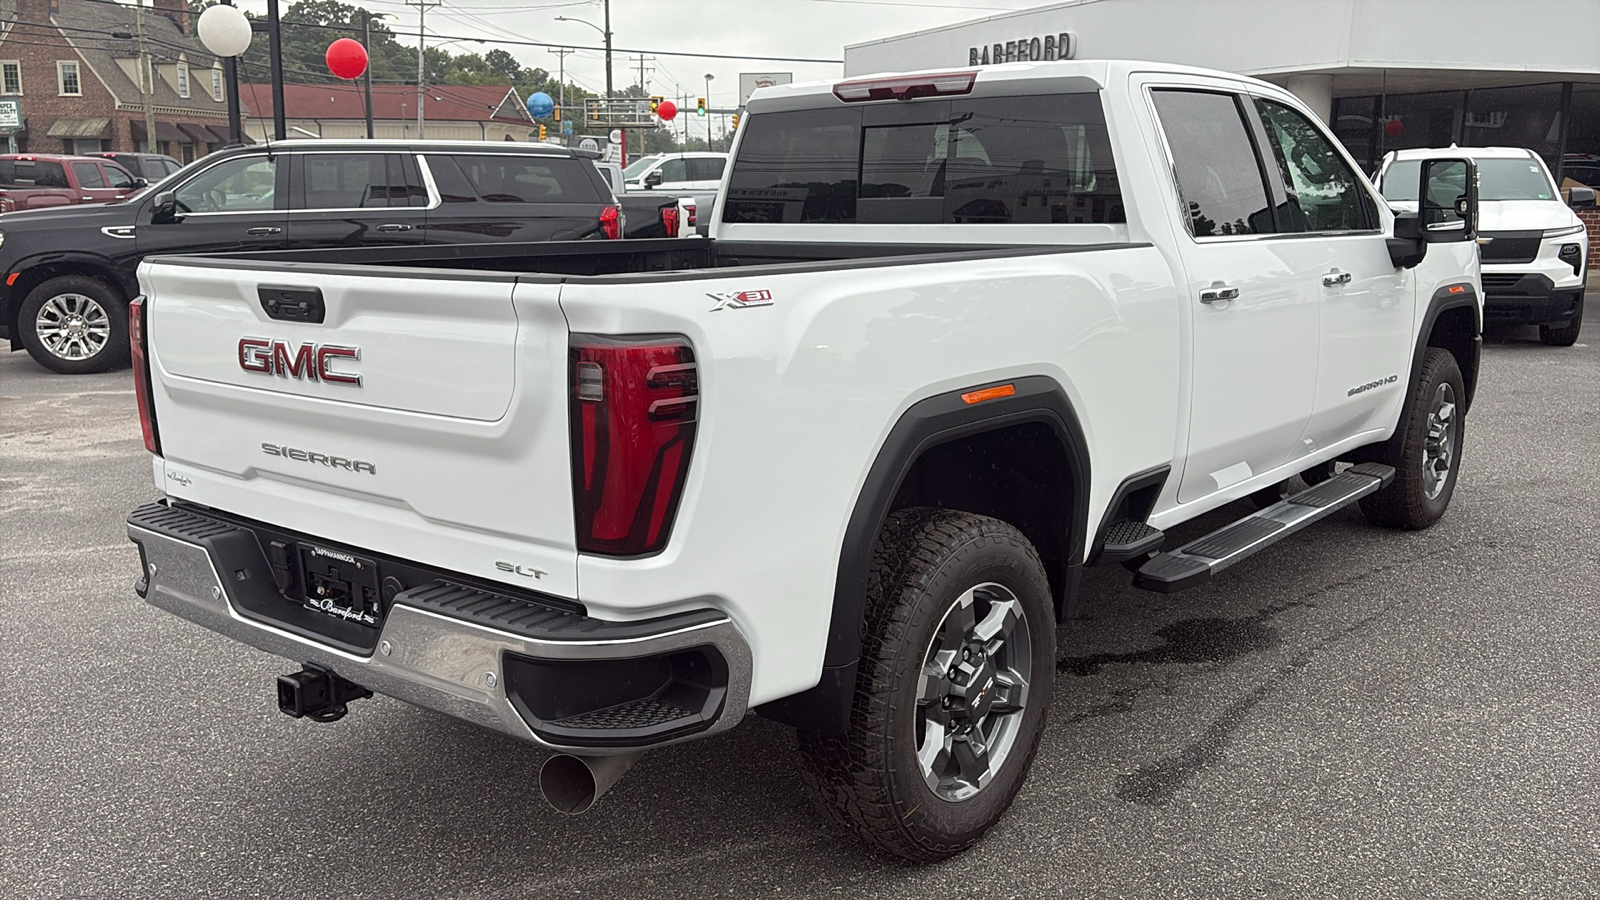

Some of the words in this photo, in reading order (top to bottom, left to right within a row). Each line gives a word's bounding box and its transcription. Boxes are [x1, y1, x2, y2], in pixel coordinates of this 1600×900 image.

[238, 336, 363, 388] GMC
[1347, 378, 1384, 397] SIERRA
[1384, 374, 1398, 385] HD
[261, 442, 376, 475] SIERRA
[314, 547, 356, 564] TAPPAHANNOCK
[495, 561, 548, 580] SLT
[320, 598, 366, 621] Bareford
